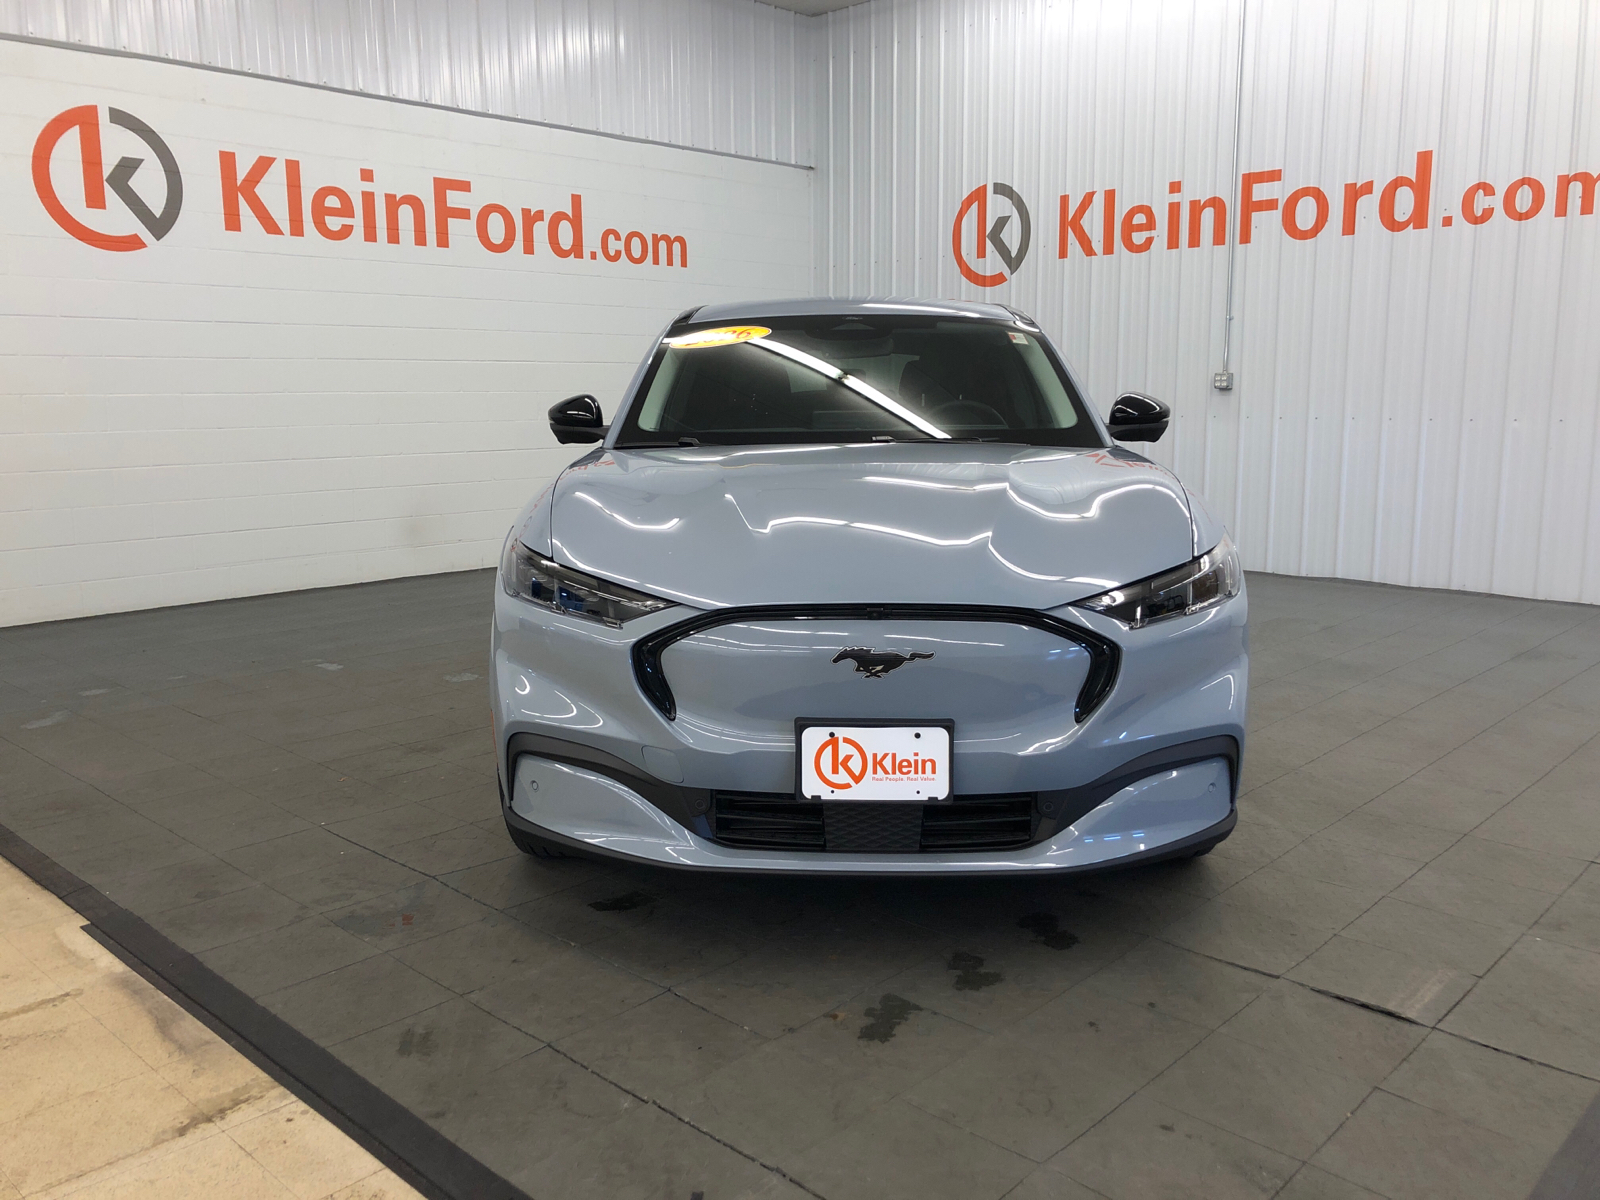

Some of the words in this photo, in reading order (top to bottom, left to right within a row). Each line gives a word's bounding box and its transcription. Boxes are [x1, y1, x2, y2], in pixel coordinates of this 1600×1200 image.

[218, 150, 688, 268] KleinFord.com
[1058, 149, 1600, 260] KleinFord.com
[872, 752, 937, 775] Klein
